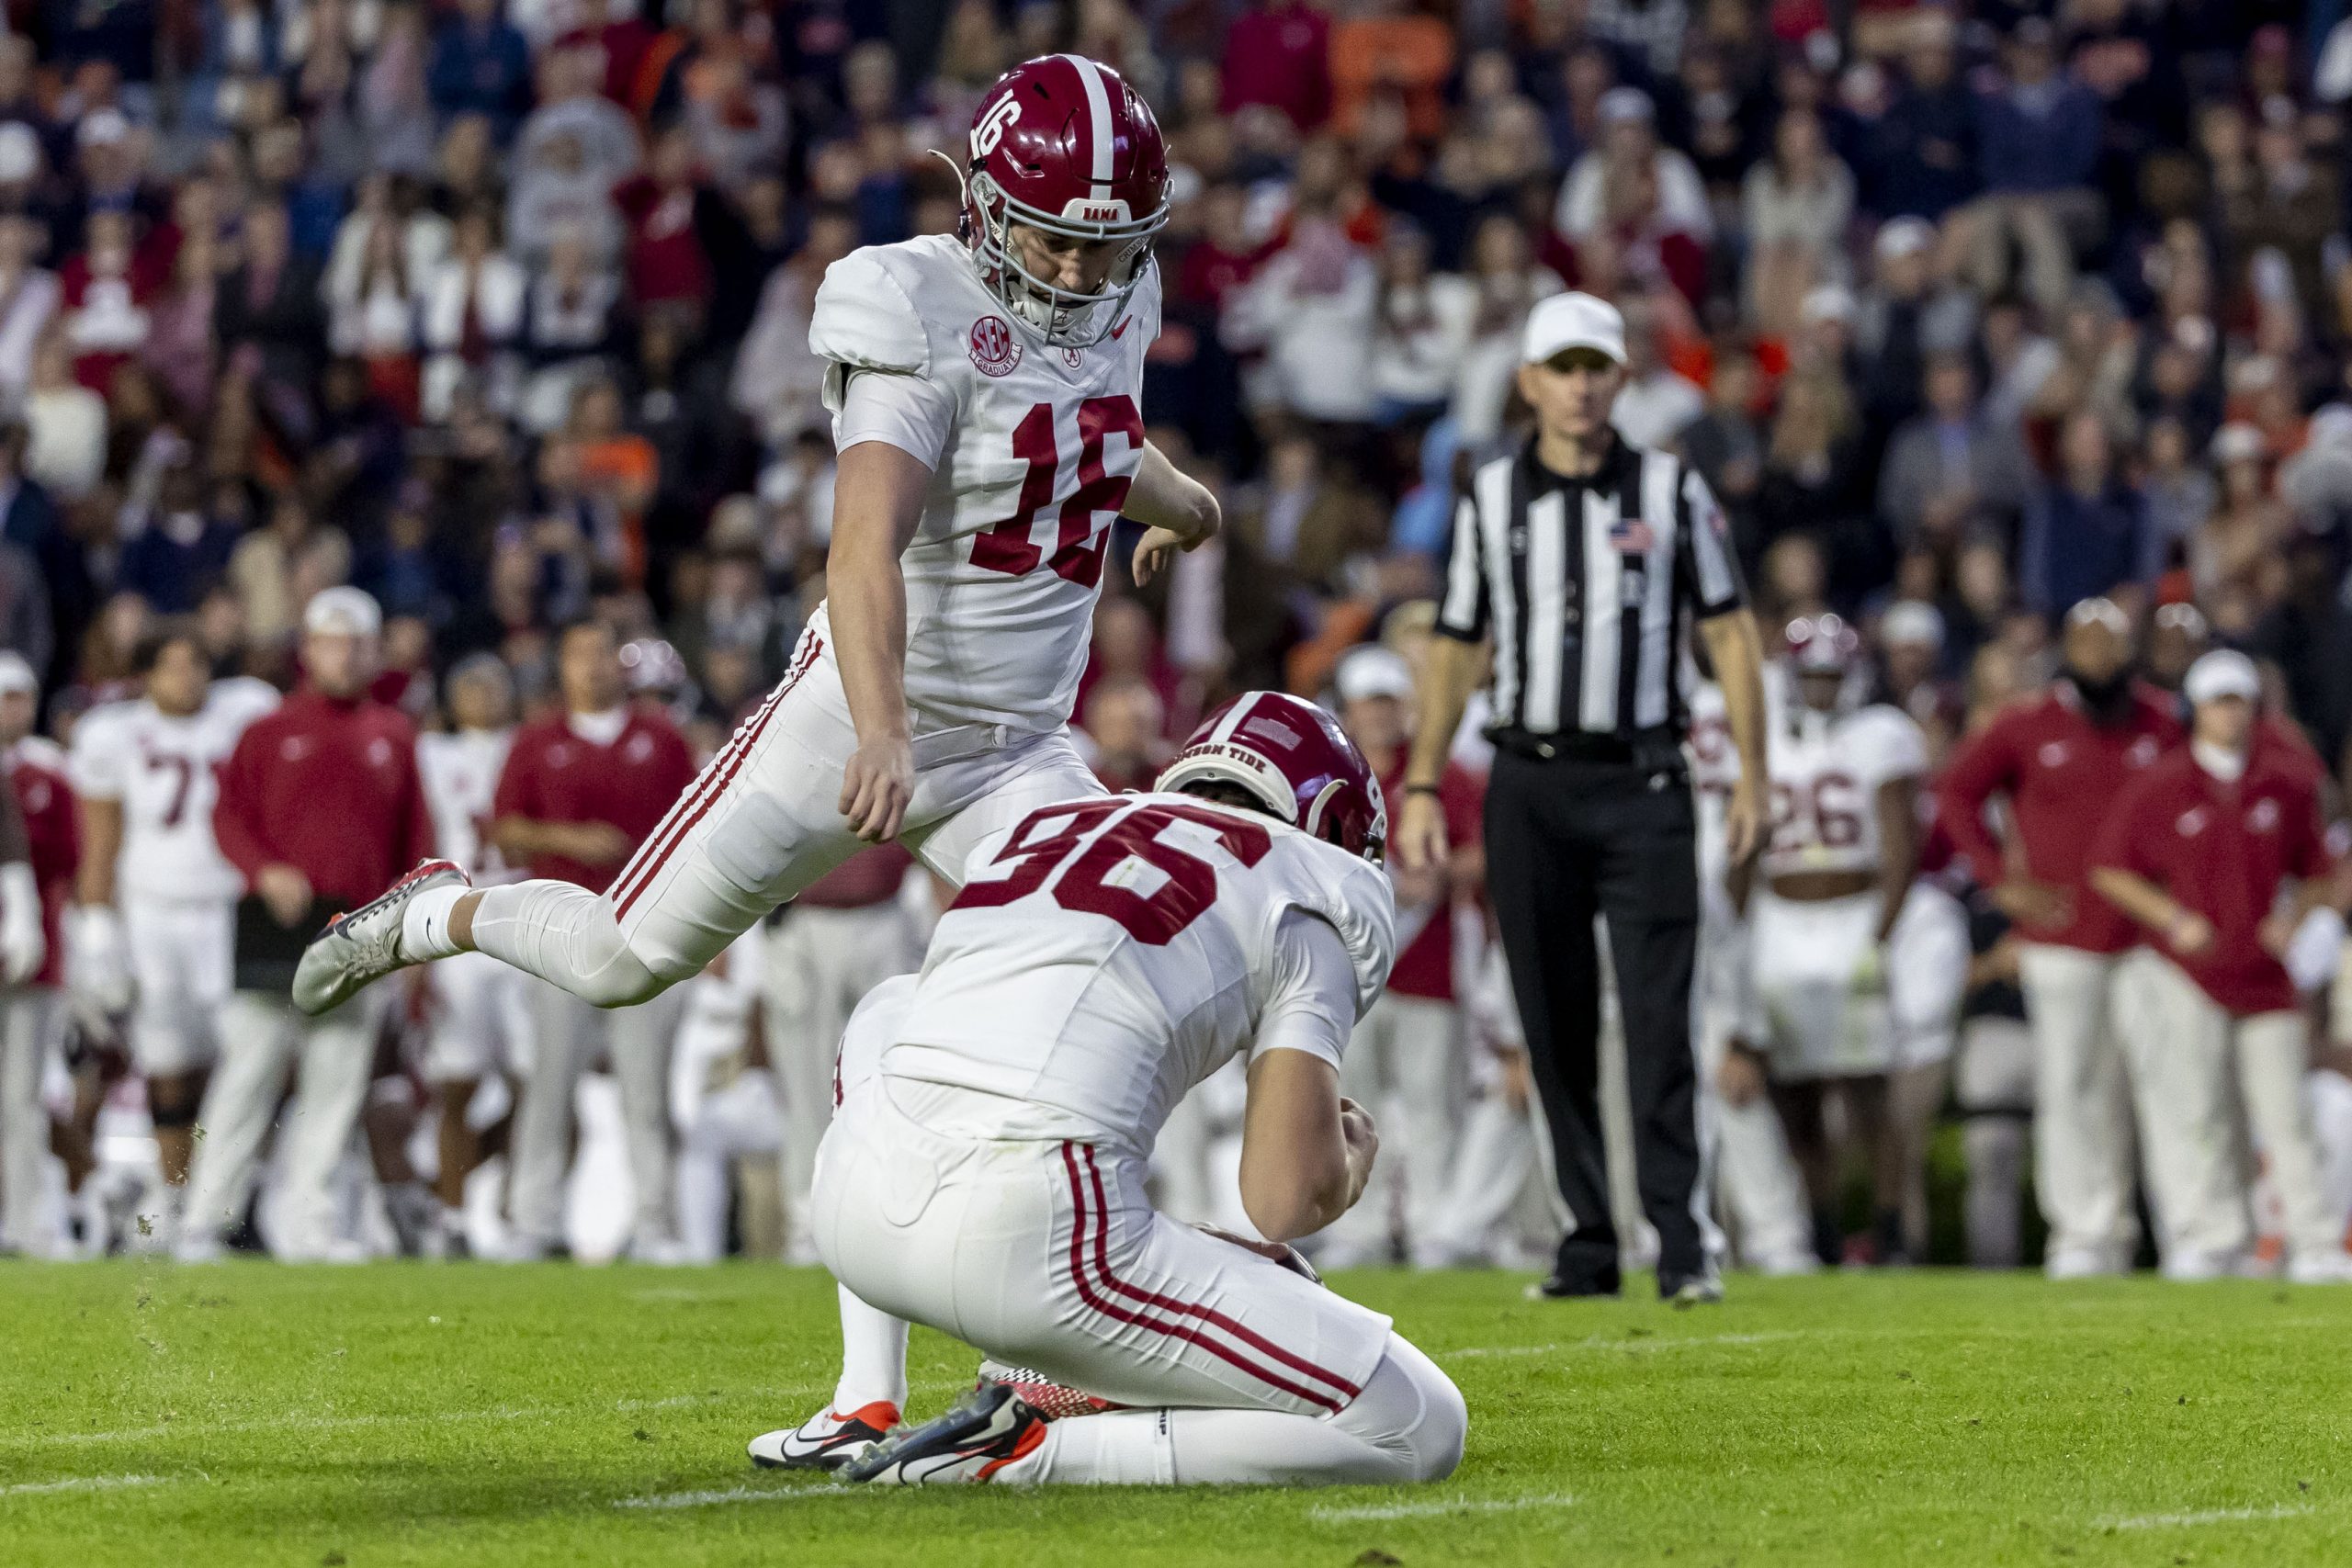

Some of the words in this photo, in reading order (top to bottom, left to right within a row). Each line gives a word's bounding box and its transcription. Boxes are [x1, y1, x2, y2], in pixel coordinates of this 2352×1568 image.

[970, 88, 1022, 160] 16
[972, 317, 1011, 361] SEC
[977, 354, 1018, 376] GRADUATE
[967, 394, 1145, 590] 16
[1229, 747, 1267, 773] TIDE
[947, 797, 1272, 947] 96
